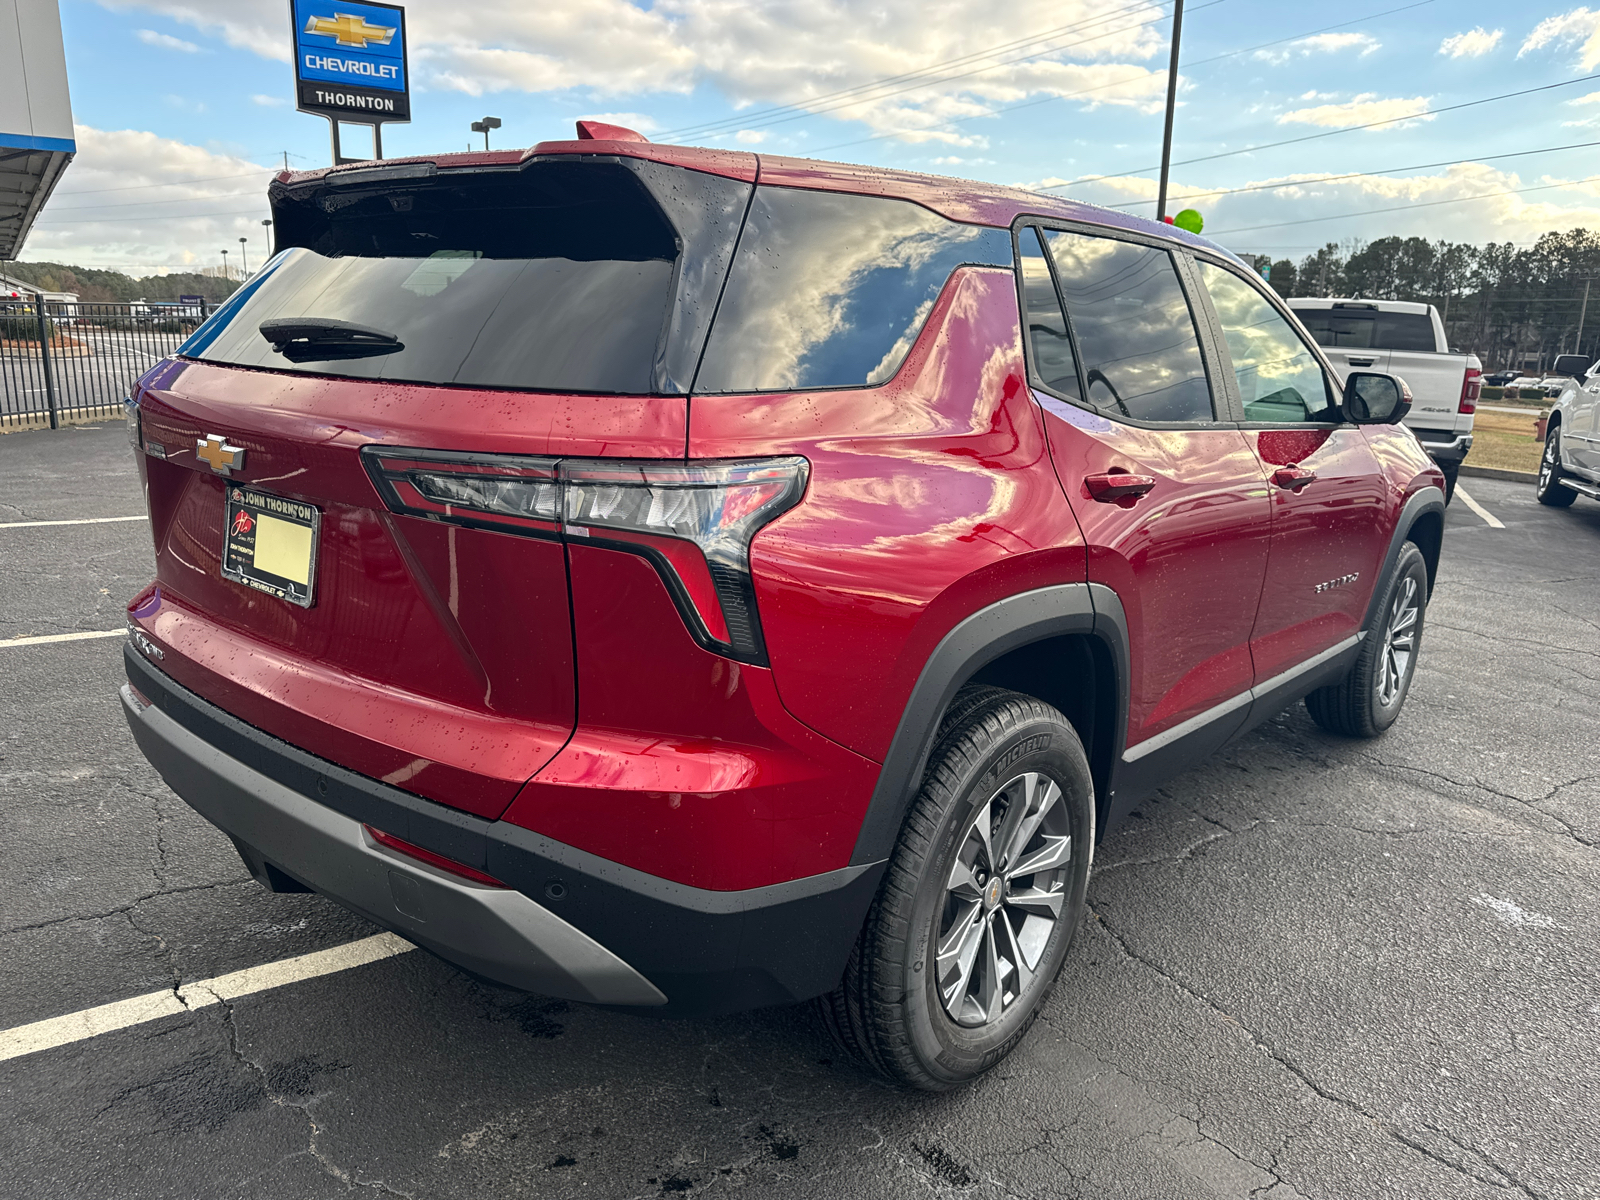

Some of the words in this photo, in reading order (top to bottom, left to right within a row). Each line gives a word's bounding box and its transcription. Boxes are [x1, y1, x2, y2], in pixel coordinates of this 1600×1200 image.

[305, 54, 399, 79] CHEVROLET
[315, 90, 395, 112] THORNTON
[245, 492, 266, 507] JOHN
[266, 498, 312, 520] THORNTON
[249, 581, 277, 595] CHEVROLET
[996, 735, 1051, 777] MICHELIN
